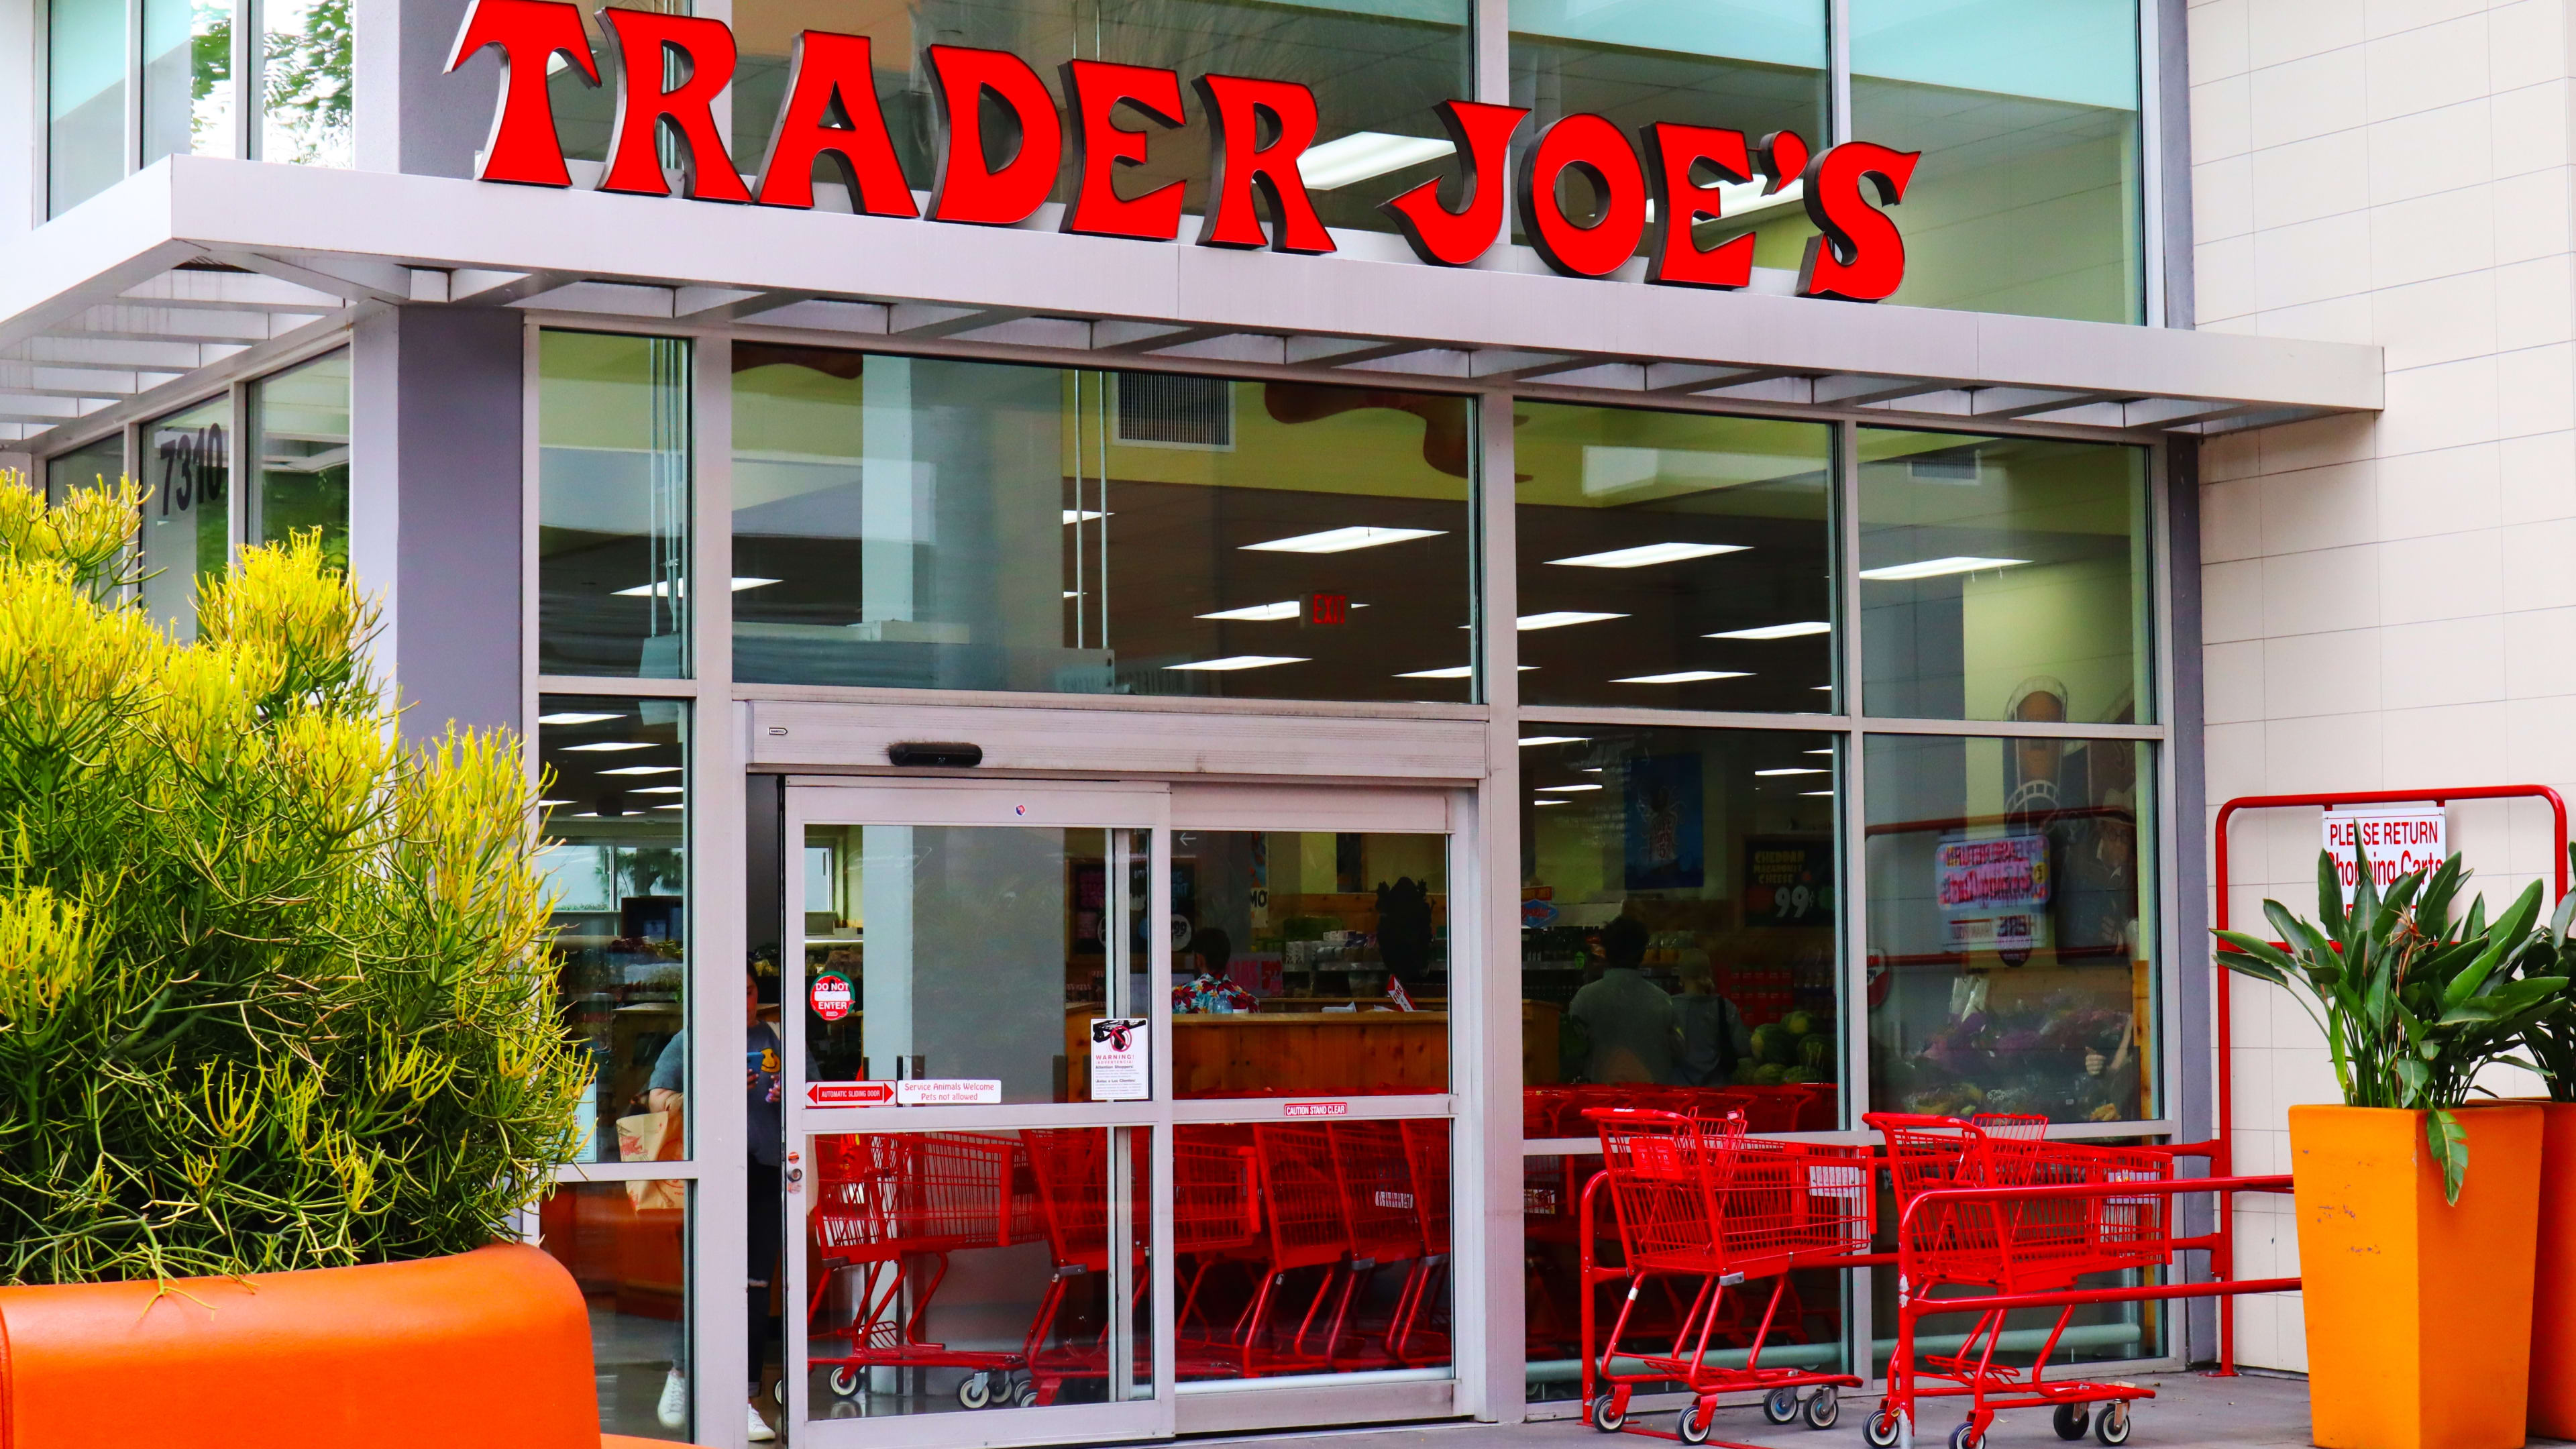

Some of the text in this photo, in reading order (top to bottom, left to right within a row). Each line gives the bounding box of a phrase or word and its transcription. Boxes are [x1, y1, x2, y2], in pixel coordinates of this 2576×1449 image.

[443, 0, 1921, 303] TRADER JOE'S
[160, 423, 223, 516] 7310
[1313, 594, 1347, 623] EXIT
[2330, 821, 2438, 846] PLESE RETURN
[816, 983, 849, 991] DO NOT
[1393, 985, 1403, 1003] FIRE
[818, 1002, 847, 1010] ENTER
[905, 1083, 994, 1091] Service Animals Welcome
[1287, 1105, 1345, 1115] CAUTION STAND CLEAR
